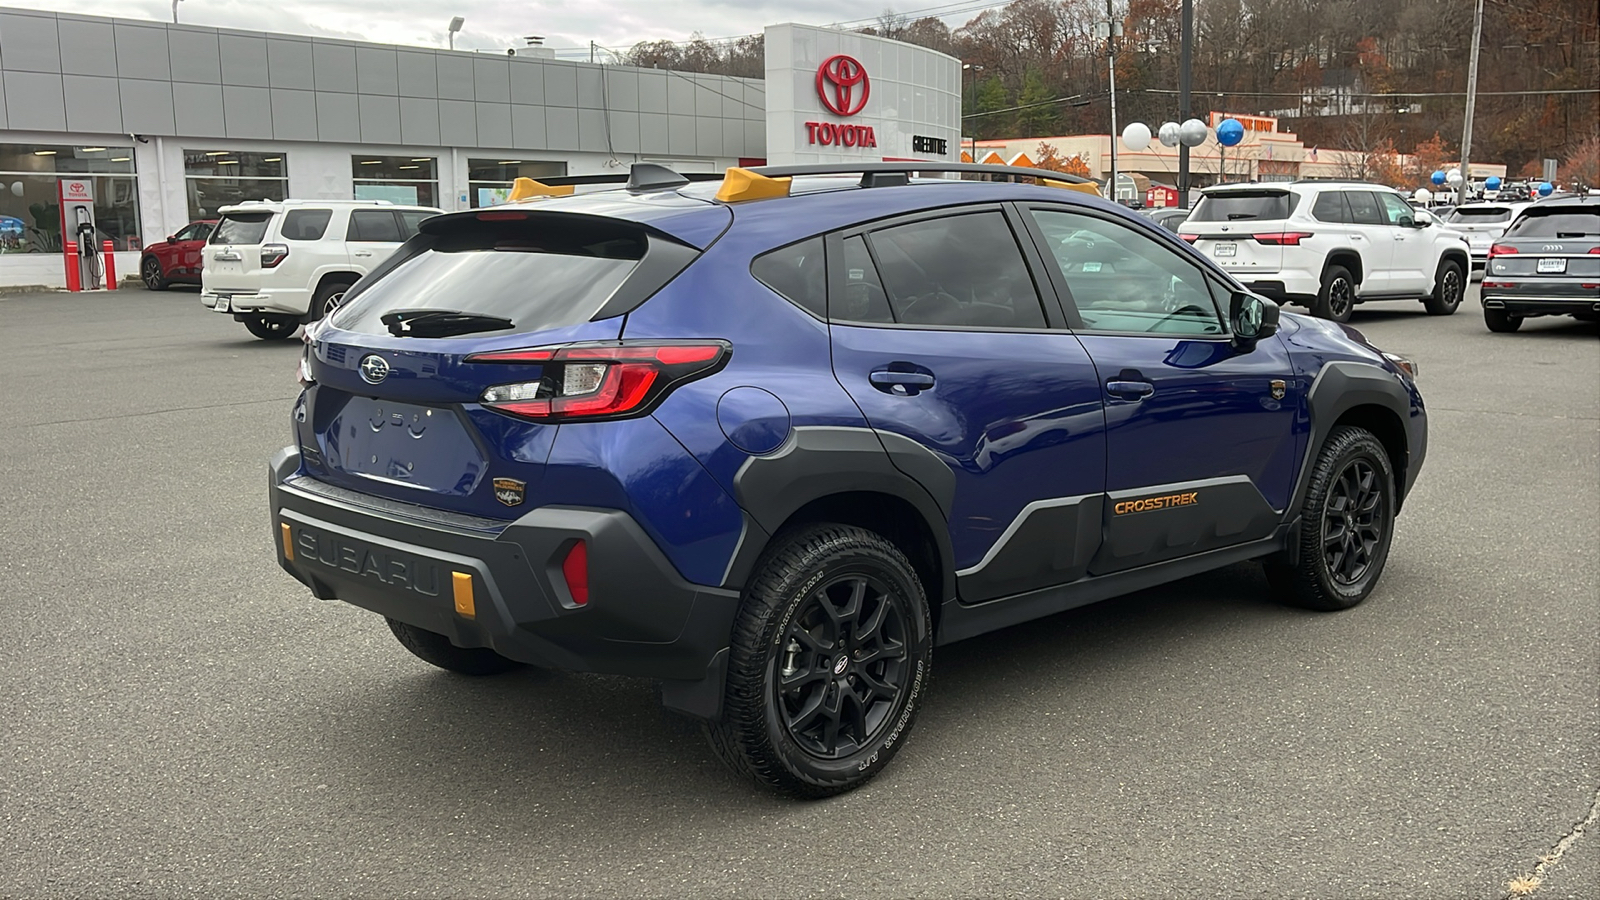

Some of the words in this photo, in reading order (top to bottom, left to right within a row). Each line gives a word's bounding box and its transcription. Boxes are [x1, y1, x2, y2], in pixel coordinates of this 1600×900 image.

[805, 122, 877, 148] TOYOTA
[1114, 491, 1198, 515] CROSSTREK
[298, 528, 440, 597] SUBARU
[774, 570, 825, 645] YOKOHAMA
[884, 660, 924, 749] GEOLANDAR
[858, 751, 879, 771] A/T
